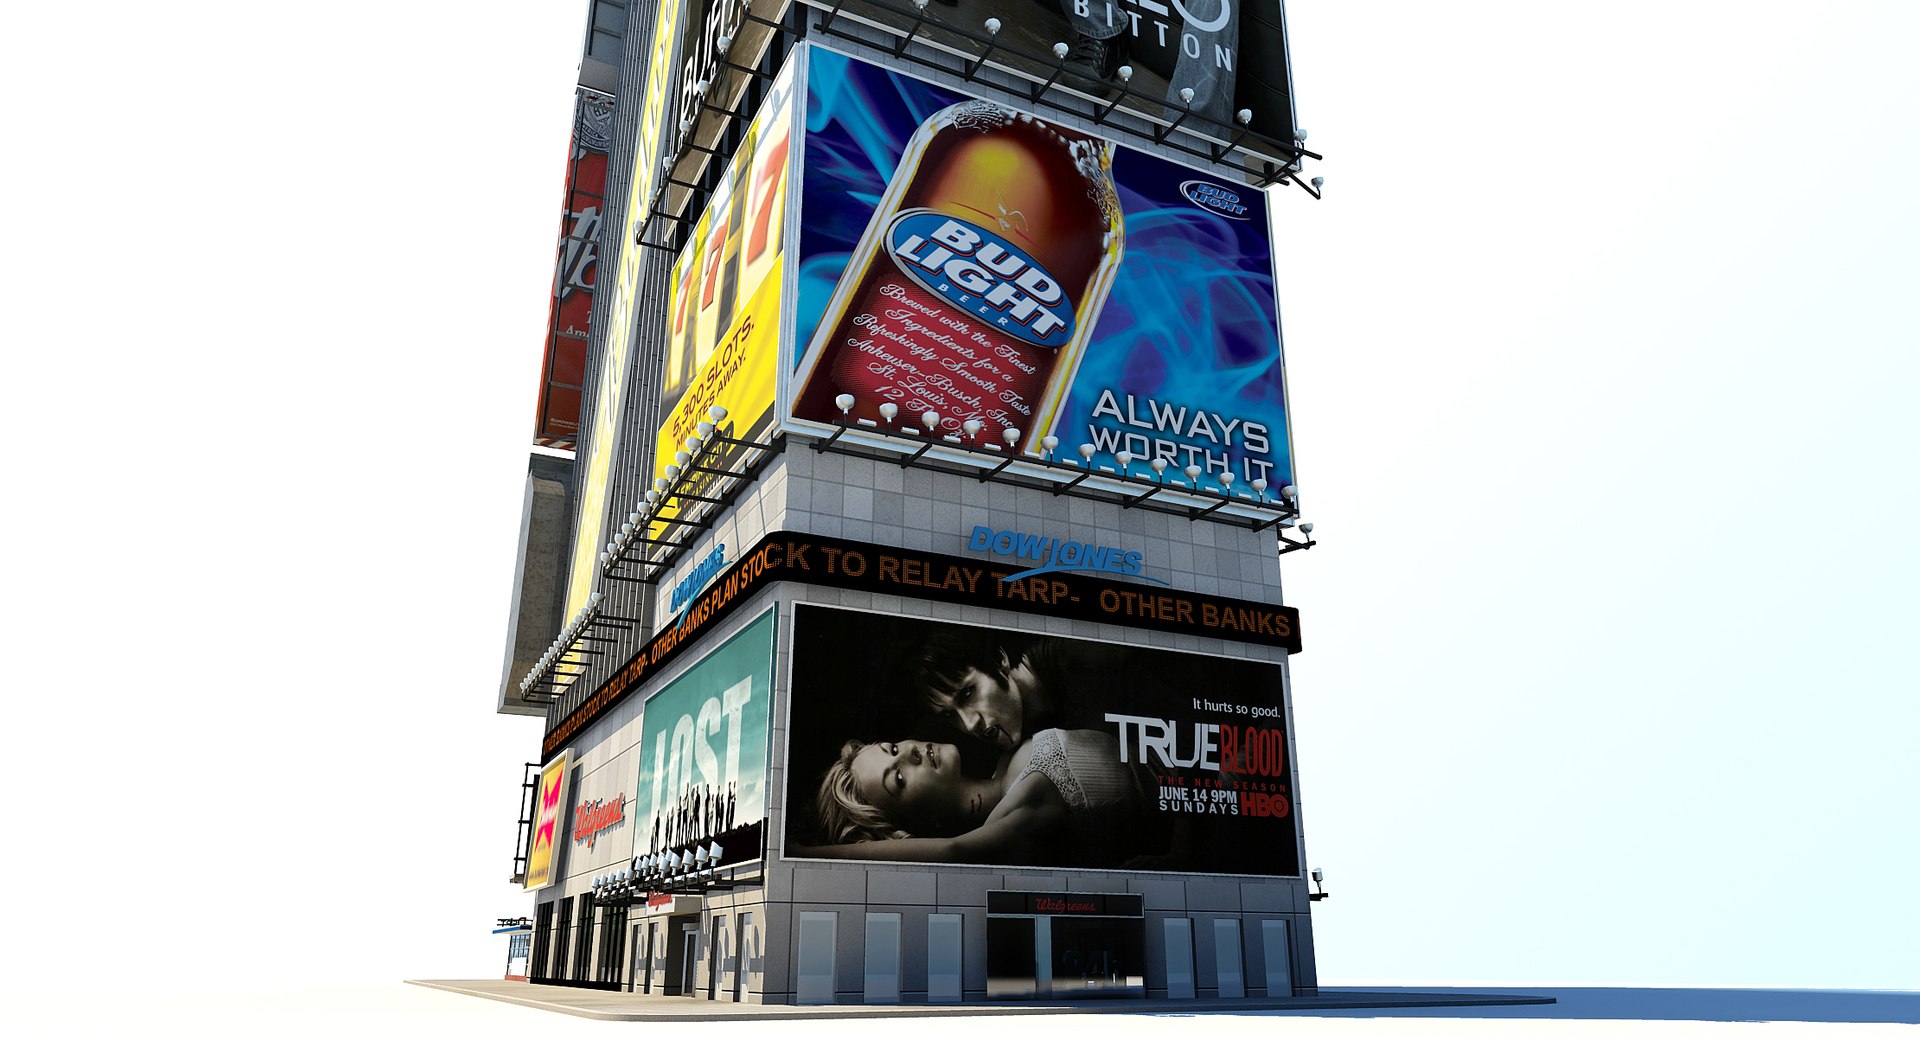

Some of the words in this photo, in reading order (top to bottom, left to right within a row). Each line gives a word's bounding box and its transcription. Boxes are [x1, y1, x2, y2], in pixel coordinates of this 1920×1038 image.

[1190, 191, 1247, 214] LIGHT
[1197, 184, 1239, 203] BUD
[895, 234, 1066, 337] LIGHT
[930, 219, 1062, 306] BUD
[880, 284, 940, 318] Brewed
[939, 314, 970, 335] with
[971, 326, 993, 348] the
[994, 344, 1037, 375] Finest
[938, 283, 1009, 327] BEER
[853, 313, 939, 361] Refreshingly
[939, 357, 998, 394] Smooth
[998, 389, 1032, 416] Taste
[885, 308, 978, 360] Ingredients
[972, 357, 1001, 375] for
[1001, 373, 1015, 383] a
[672, 382, 705, 439] 5,300
[705, 314, 755, 391] SLOTS.
[675, 390, 715, 451] MINUTES
[715, 347, 746, 397] AWAY.
[866, 361, 898, 381] St.
[897, 375, 948, 410] Louis,
[874, 385, 905, 401] 12
[1091, 389, 1269, 454] ALWAYS
[1088, 424, 1230, 474] WORTH
[1243, 456, 1274, 483] IT
[968, 525, 1049, 561] DOW
[1042, 537, 1143, 576] JONES
[651, 625, 678, 665] OTHER
[678, 596, 710, 643] BANKS
[710, 570, 739, 615] PLAN
[821, 546, 867, 577] TO
[879, 554, 983, 594] RELAY
[1100, 588, 1195, 625] OTHER
[1202, 602, 1291, 638] BANKS
[1193, 698, 1201, 710] It
[1204, 699, 1233, 713] hurts
[1235, 704, 1248, 715] so
[1251, 706, 1281, 718] good.
[650, 675, 752, 852] LOST
[1104, 713, 1220, 771] TRUE
[1220, 723, 1283, 777] BLOOD
[1158, 775, 1185, 786] THE
[1194, 777, 1223, 788] NEW
[1233, 780, 1286, 792] SEASON
[1159, 786, 1189, 800] JUNE
[1193, 788, 1208, 802] 14
[1211, 789, 1237, 804] 9PM
[1159, 801, 1239, 815] SUNDAYS
[1240, 791, 1289, 818] HBO
[1035, 897, 1096, 914] Walgreens
